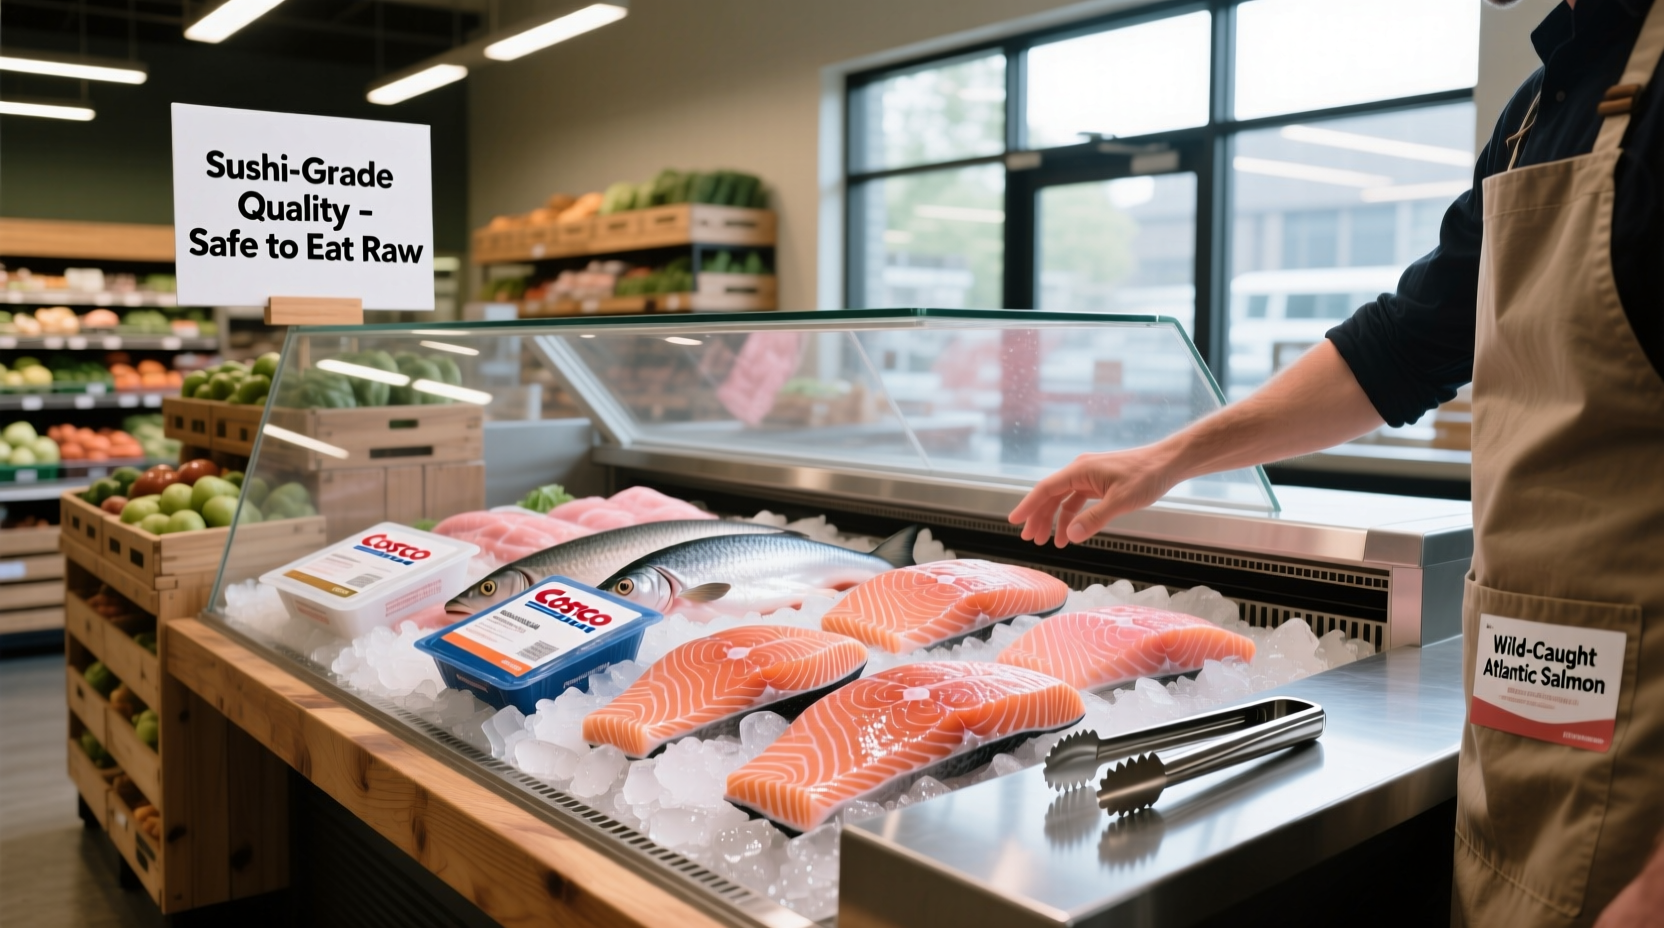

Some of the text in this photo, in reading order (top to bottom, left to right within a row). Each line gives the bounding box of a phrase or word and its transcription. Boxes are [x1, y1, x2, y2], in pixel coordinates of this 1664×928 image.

[205, 149, 395, 190] Sushi-Grade
[237, 190, 352, 232] Quality
[189, 227, 425, 264] Safe to Eat Raw
[1493, 634, 1599, 670] Wild-Caught
[1483, 657, 1606, 695] Atlantic Salmon
